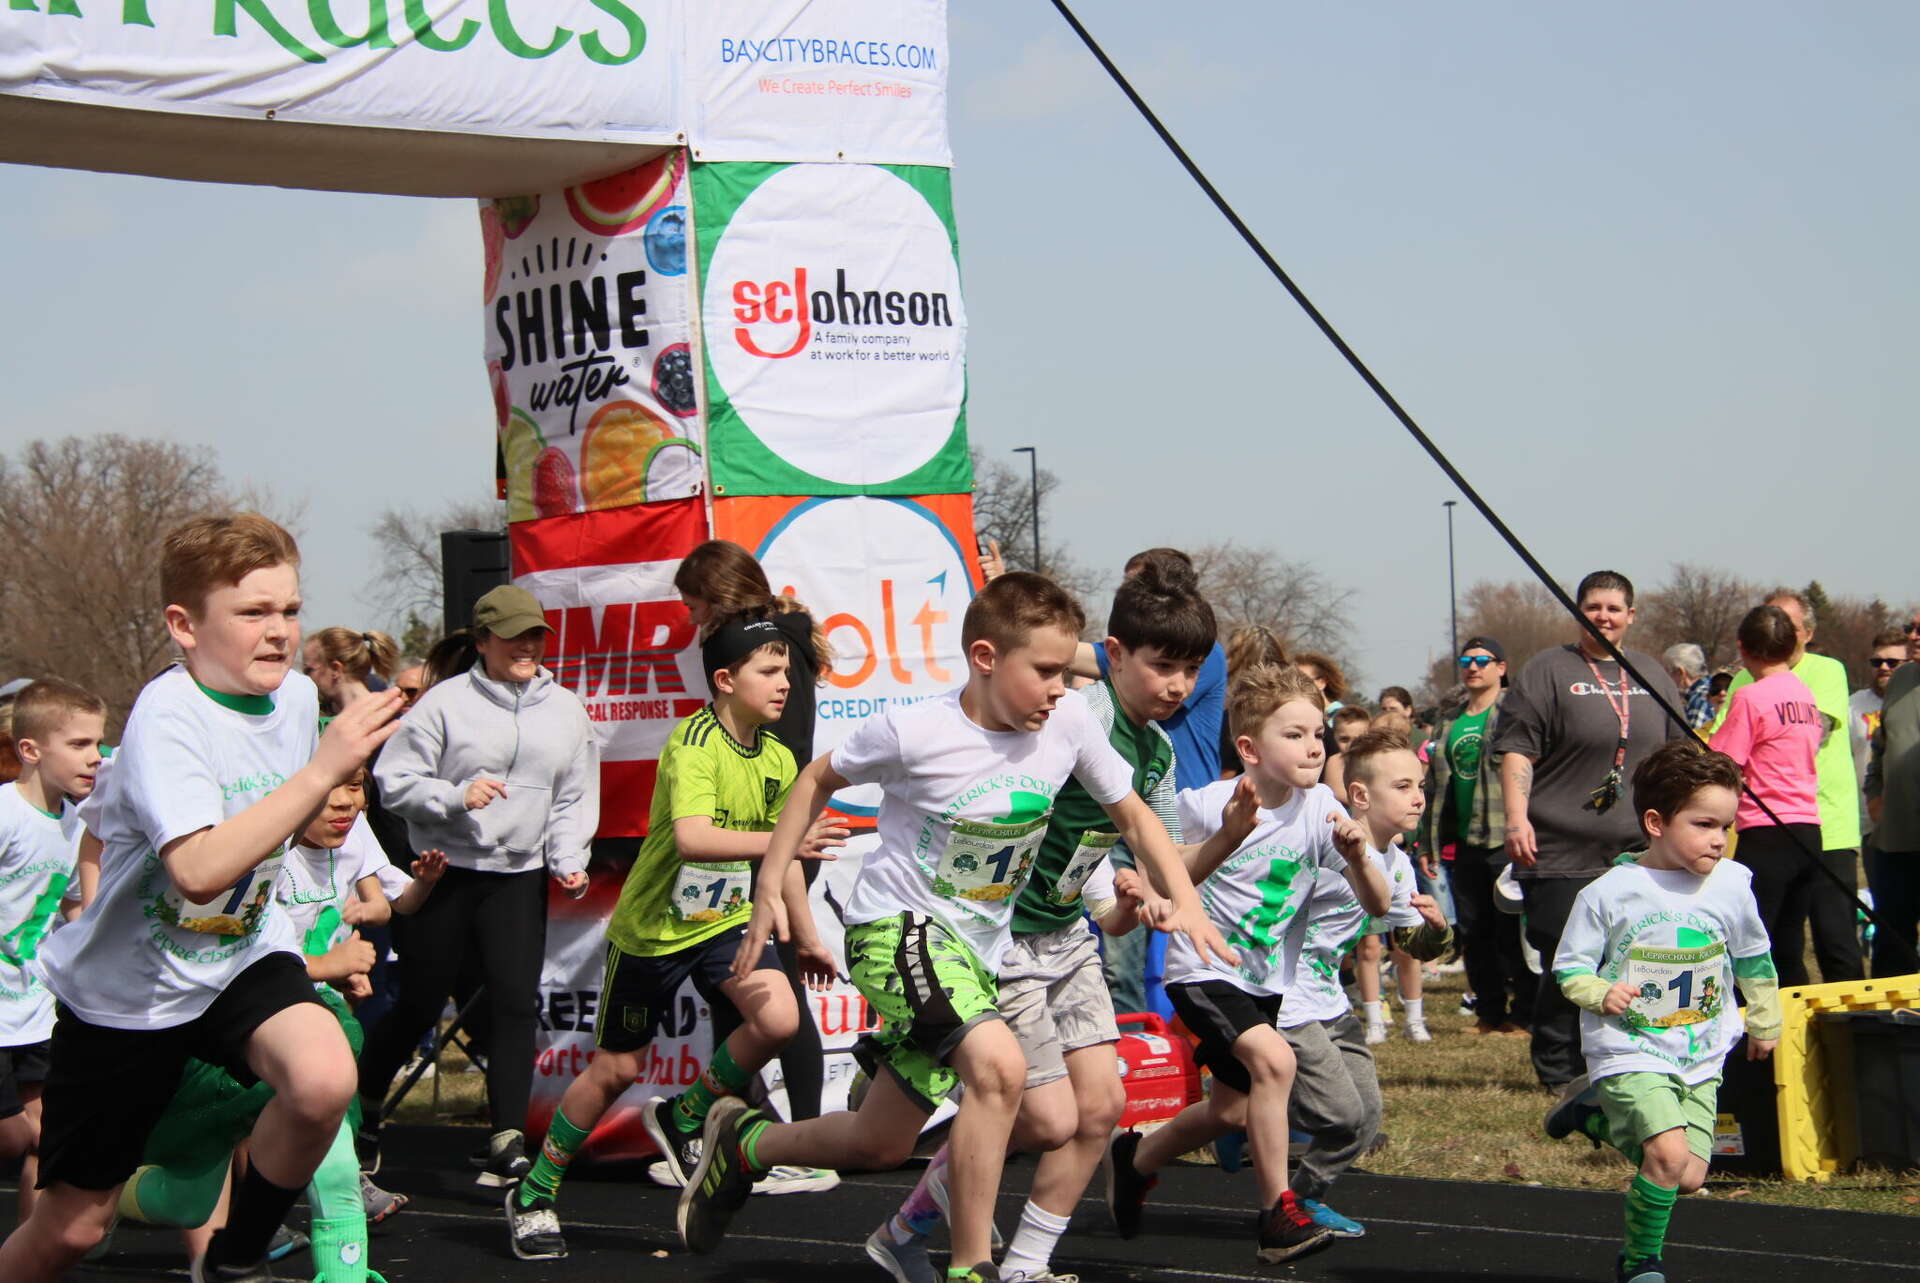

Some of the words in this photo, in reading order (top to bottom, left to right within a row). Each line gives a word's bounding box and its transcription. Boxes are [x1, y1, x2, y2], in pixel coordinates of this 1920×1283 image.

[722, 38, 936, 70] BAYCITYBRACES.COM
[758, 79, 779, 94] We
[783, 79, 824, 96] Create
[828, 80, 872, 97] Perfect
[875, 82, 912, 98] Smiles
[496, 270, 649, 371] SHINE
[814, 332, 822, 343] A
[825, 331, 859, 346] family
[861, 333, 911, 345] company
[810, 350, 822, 360] at
[824, 350, 854, 361] work
[854, 350, 870, 361] for
[873, 353, 880, 361] a
[883, 350, 917, 361] better
[919, 350, 950, 361] world
[531, 350, 630, 436] water
[610, 700, 669, 721] RESPONSE
[817, 698, 887, 719] CREDIT
[986, 845, 1015, 883] 1
[706, 878, 727, 908] 1
[1668, 970, 1693, 1009] 1
